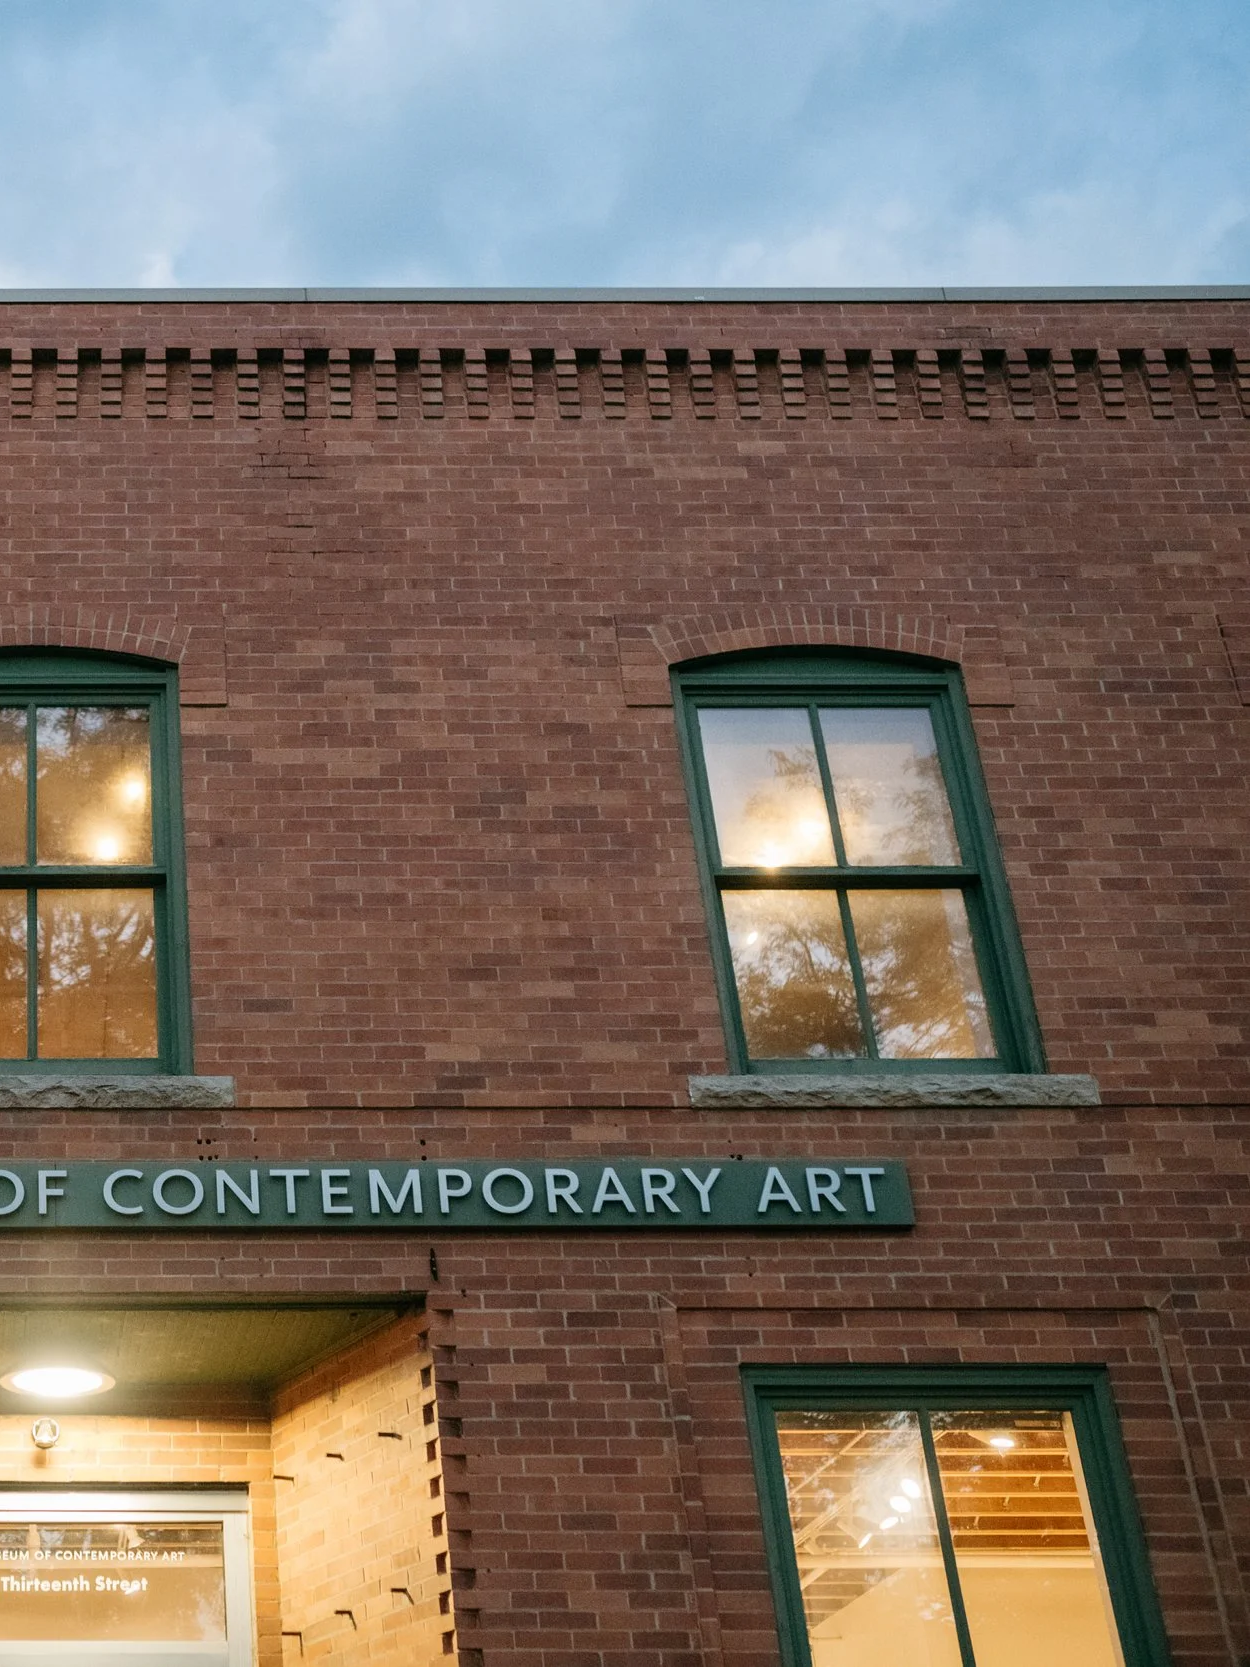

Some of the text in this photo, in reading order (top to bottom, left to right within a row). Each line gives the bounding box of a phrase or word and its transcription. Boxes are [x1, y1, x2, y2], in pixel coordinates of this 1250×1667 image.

[102, 1167, 723, 1215] CONTEMPORARY
[756, 1167, 887, 1213] ART
[34, 1551, 51, 1561] OF
[55, 1551, 158, 1562] CONTEMPORARY
[162, 1551, 185, 1562] ART
[0, 1575, 90, 1593] Thirteenth
